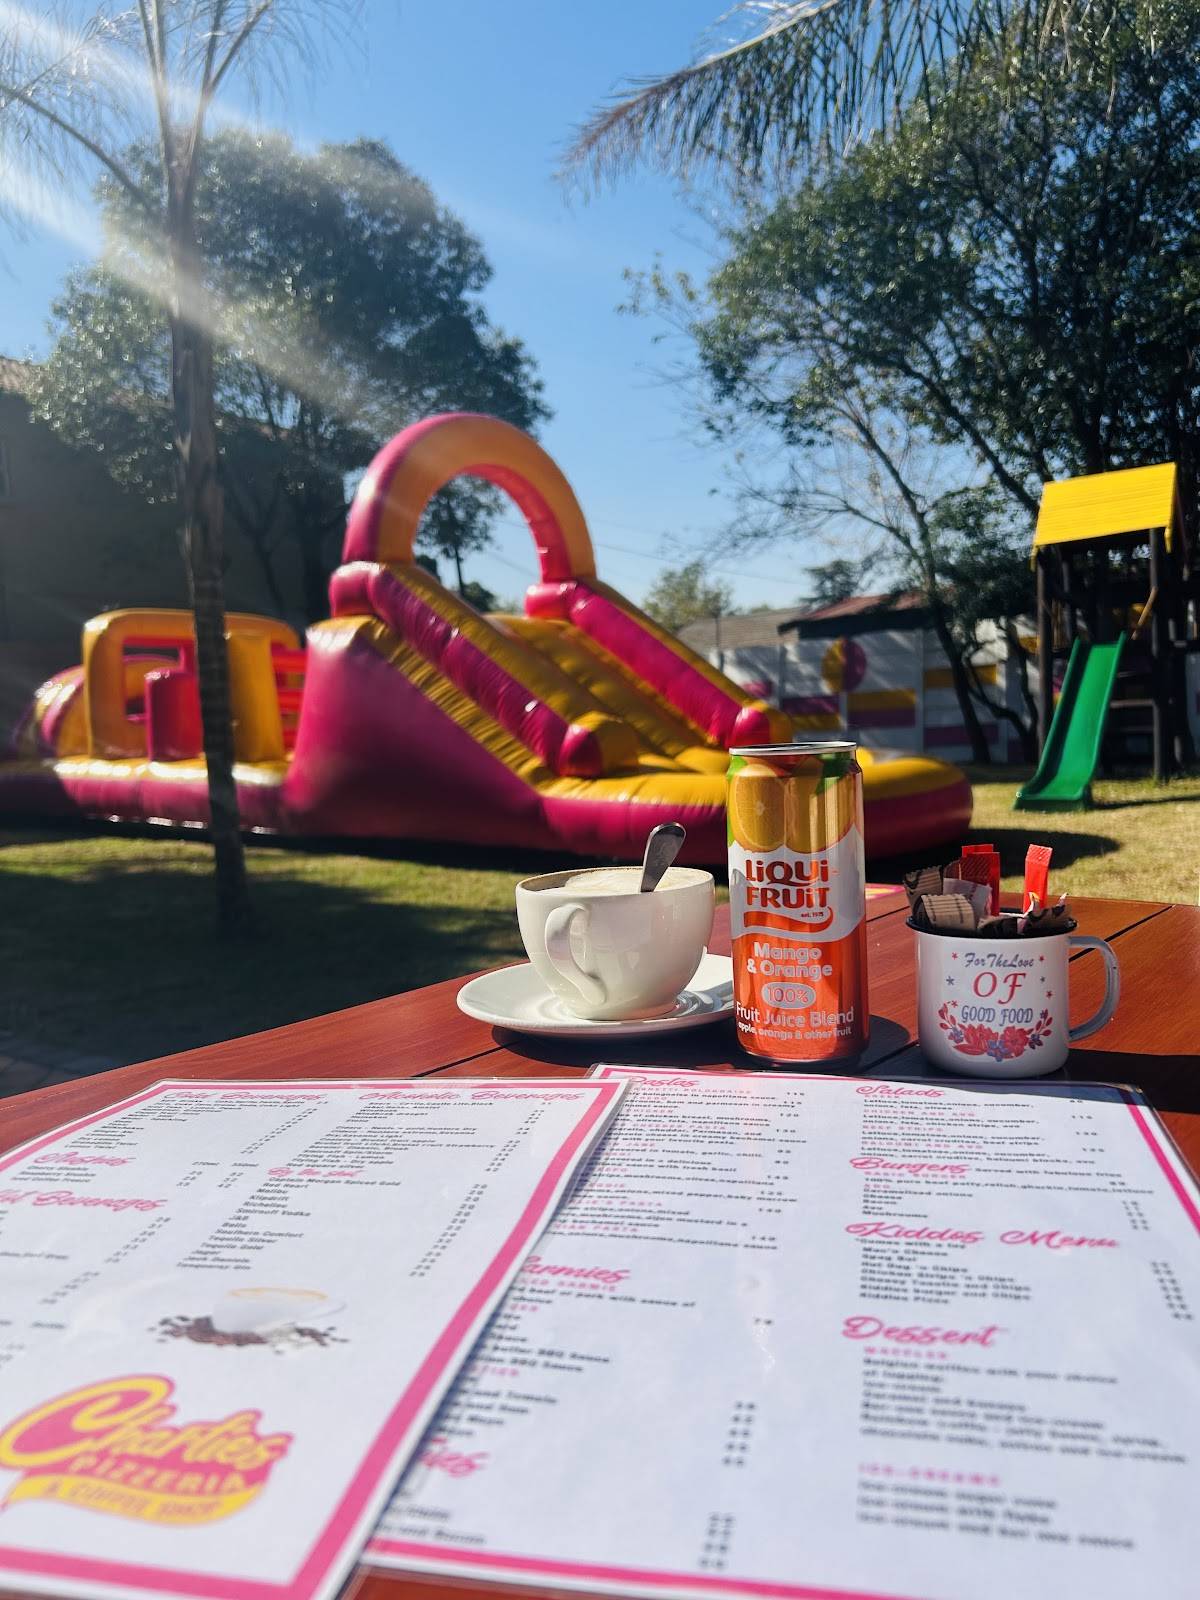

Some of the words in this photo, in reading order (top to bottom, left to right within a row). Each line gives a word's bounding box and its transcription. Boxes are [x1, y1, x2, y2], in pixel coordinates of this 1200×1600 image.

[746, 887, 830, 908] FRUiT
[754, 942, 822, 964] Mango
[747, 958, 757, 974] &
[760, 959, 833, 981] Orange
[768, 987, 809, 1003] 100%
[972, 971, 1027, 1004] OF
[736, 1001, 760, 1023] Fruit
[763, 1009, 806, 1027] Juice
[809, 1006, 854, 1027] Blend
[960, 1004, 996, 1023] GOOD
[1000, 1007, 1033, 1026] FOOD
[472, 1091, 584, 1101] Beverages
[856, 1085, 944, 1097] Salads
[850, 1157, 970, 1173] Burgers
[845, 1222, 984, 1243] Kiddos
[1000, 1230, 1119, 1249] Menu
[842, 1316, 1009, 1347] Dessert
